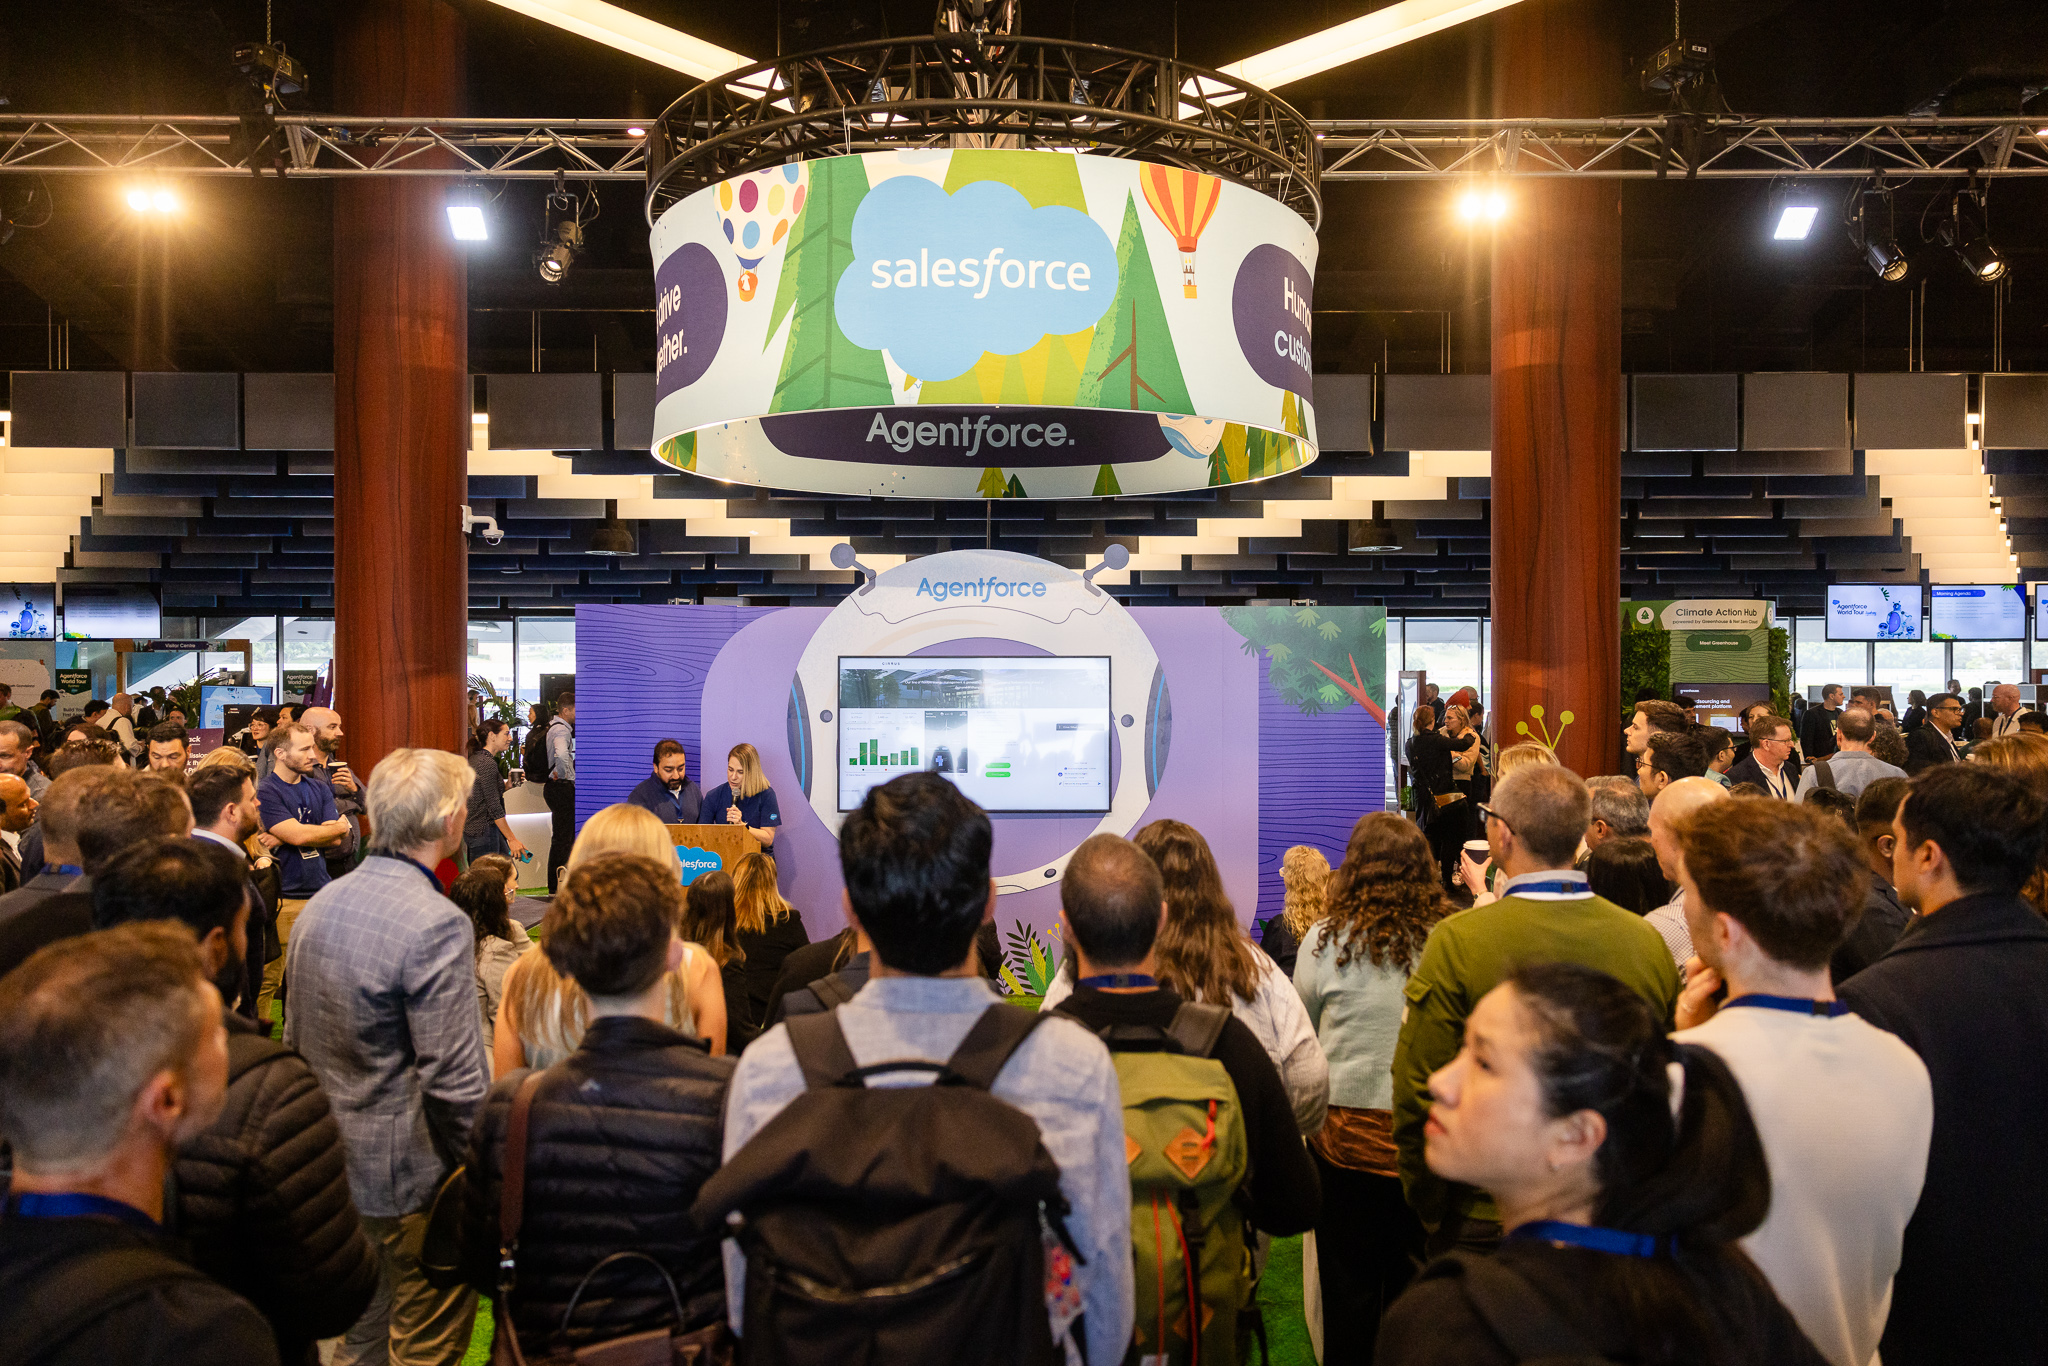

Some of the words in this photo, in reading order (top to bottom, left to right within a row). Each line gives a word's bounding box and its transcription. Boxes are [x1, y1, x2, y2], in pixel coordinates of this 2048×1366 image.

[871, 247, 1092, 300] salesforce
[865, 412, 1075, 457] Agentforce.
[915, 576, 1047, 603] Agentforce
[1675, 608, 1713, 616] Climate
[1715, 608, 1742, 616] Action
[1744, 608, 1757, 616] Hub
[1837, 603, 1868, 611] Agentforce
[679, 859, 717, 870] alesforce
